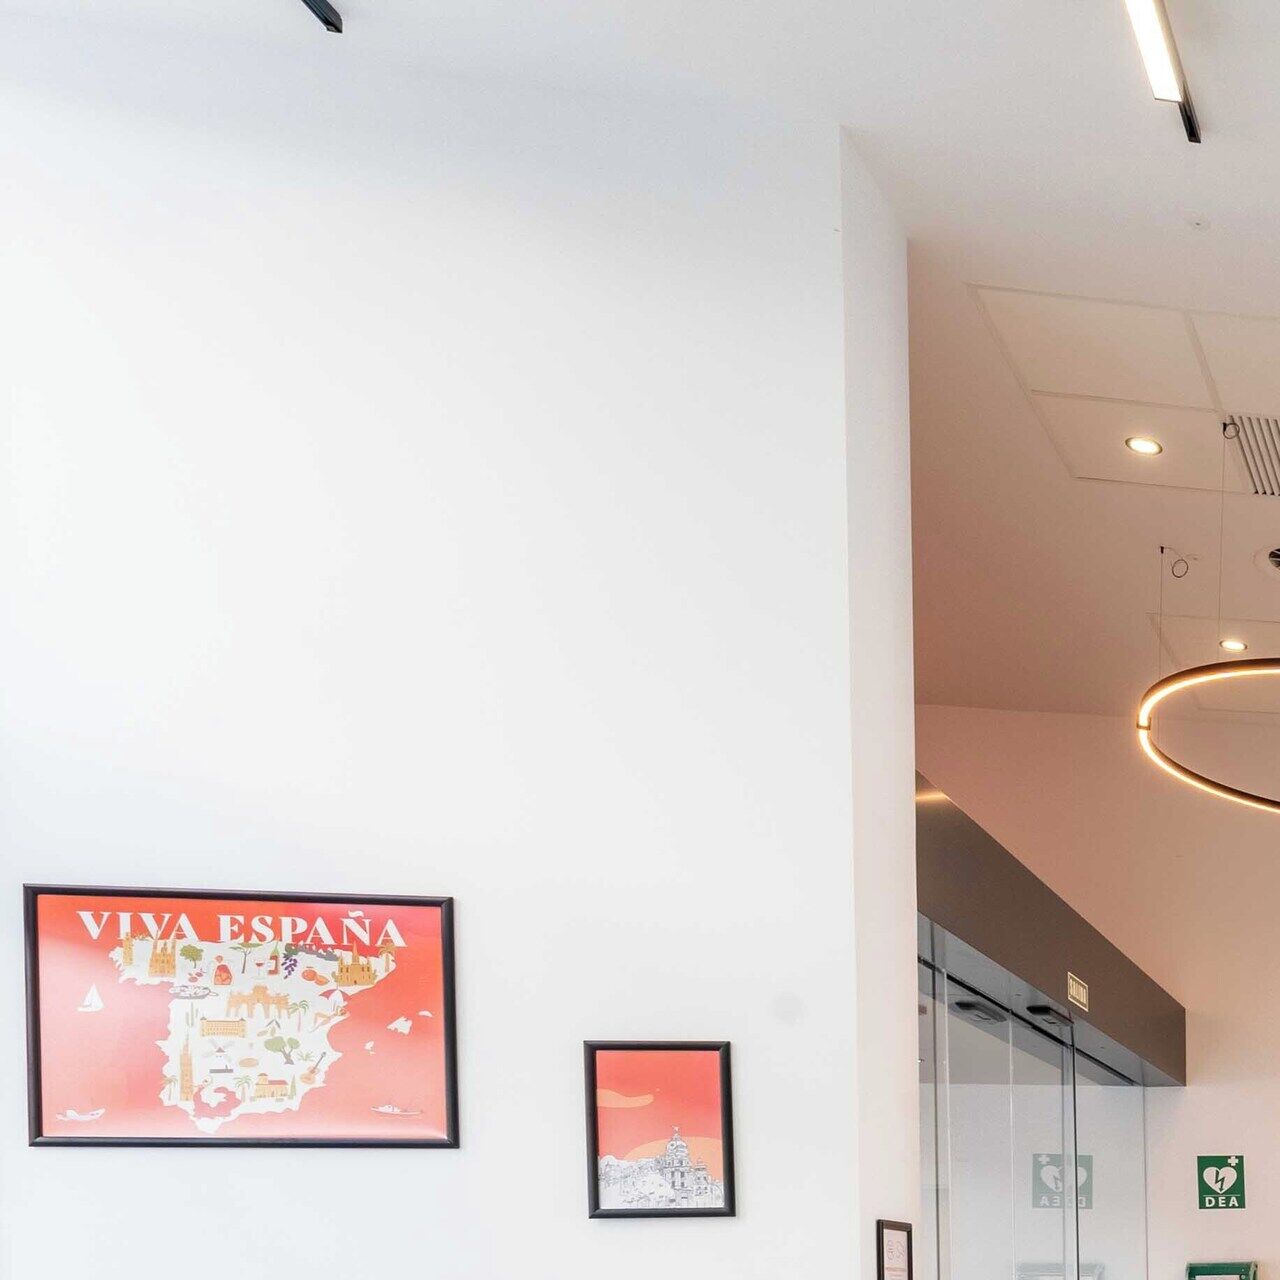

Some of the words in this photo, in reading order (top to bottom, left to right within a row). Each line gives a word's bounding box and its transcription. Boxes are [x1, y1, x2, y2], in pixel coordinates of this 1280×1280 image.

[76, 910, 201, 942] VIVA
[217, 909, 408, 948] ESPAÑA
[1205, 1196, 1240, 1208] DEA
